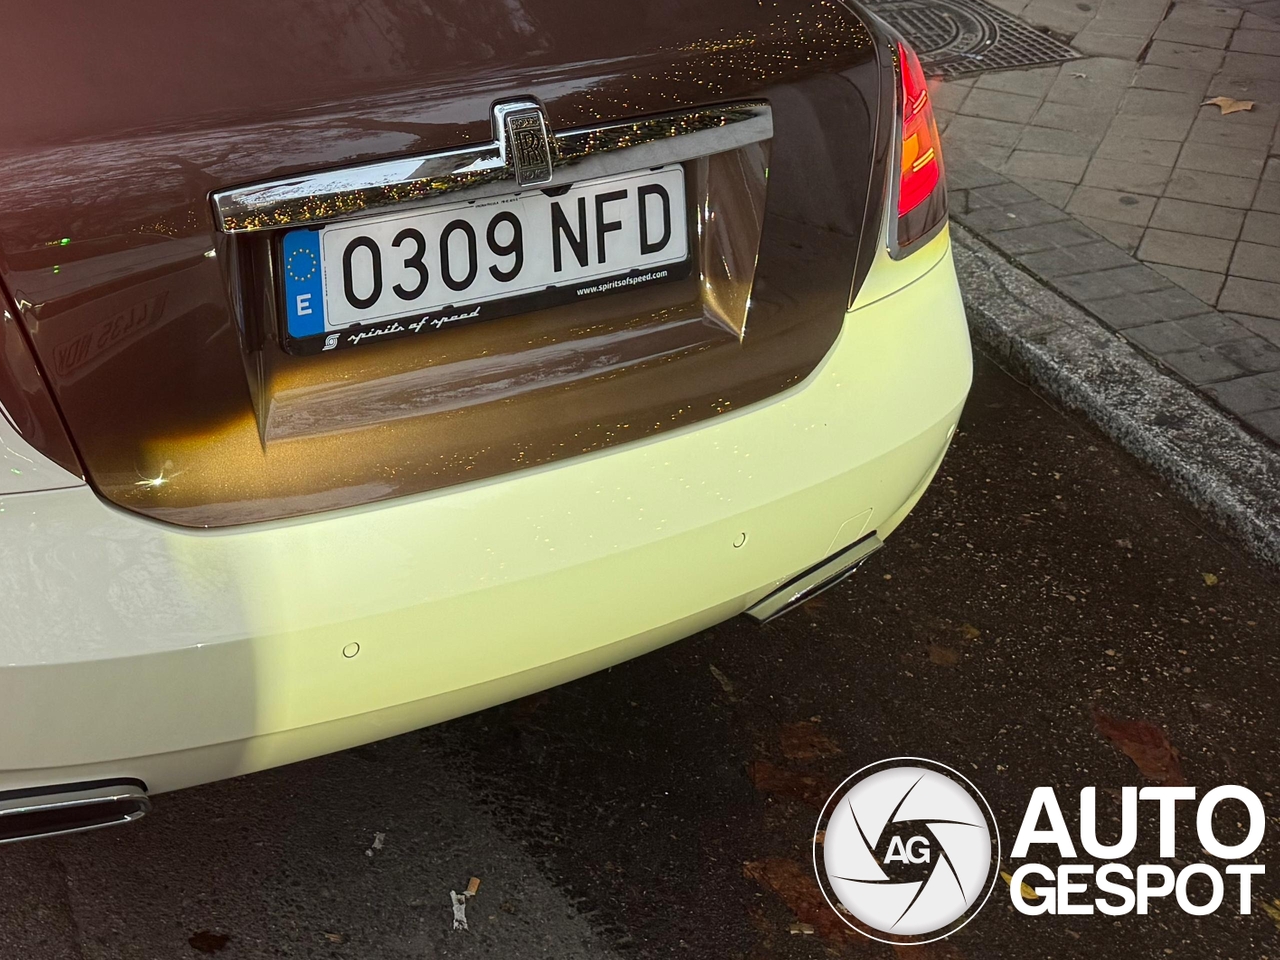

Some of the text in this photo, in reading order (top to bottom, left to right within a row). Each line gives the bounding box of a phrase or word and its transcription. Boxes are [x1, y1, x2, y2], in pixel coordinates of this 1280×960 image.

[342, 184, 671, 310] 0309 NFD
[576, 269, 668, 296] www.spiritsofspeed.com
[296, 293, 313, 316] E
[348, 306, 481, 344] spirits of speed
